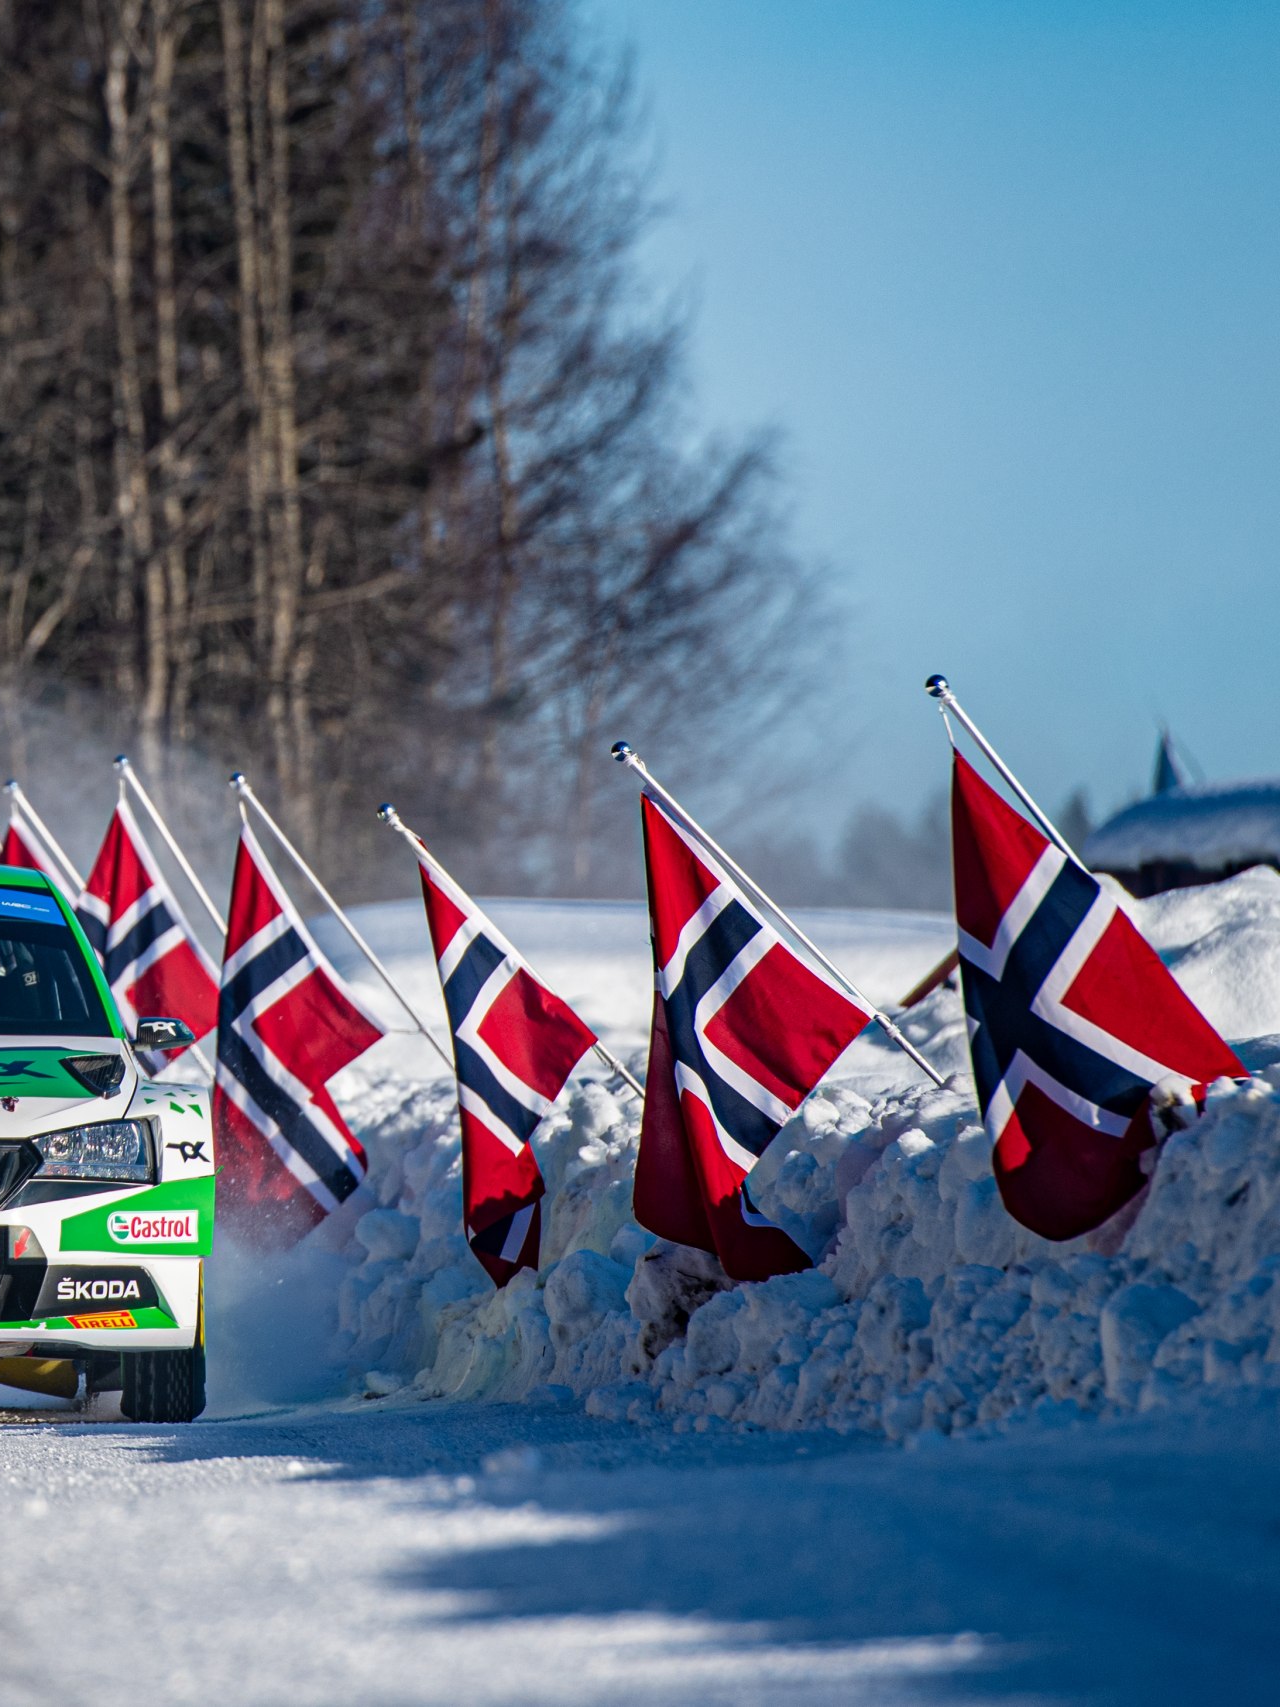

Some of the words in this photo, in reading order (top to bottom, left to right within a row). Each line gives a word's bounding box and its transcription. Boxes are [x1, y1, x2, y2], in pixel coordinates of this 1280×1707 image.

[130, 1216, 192, 1239] Castrol
[57, 1277, 141, 1300] ŠKODA
[66, 1310, 138, 1329] PIRELLI
